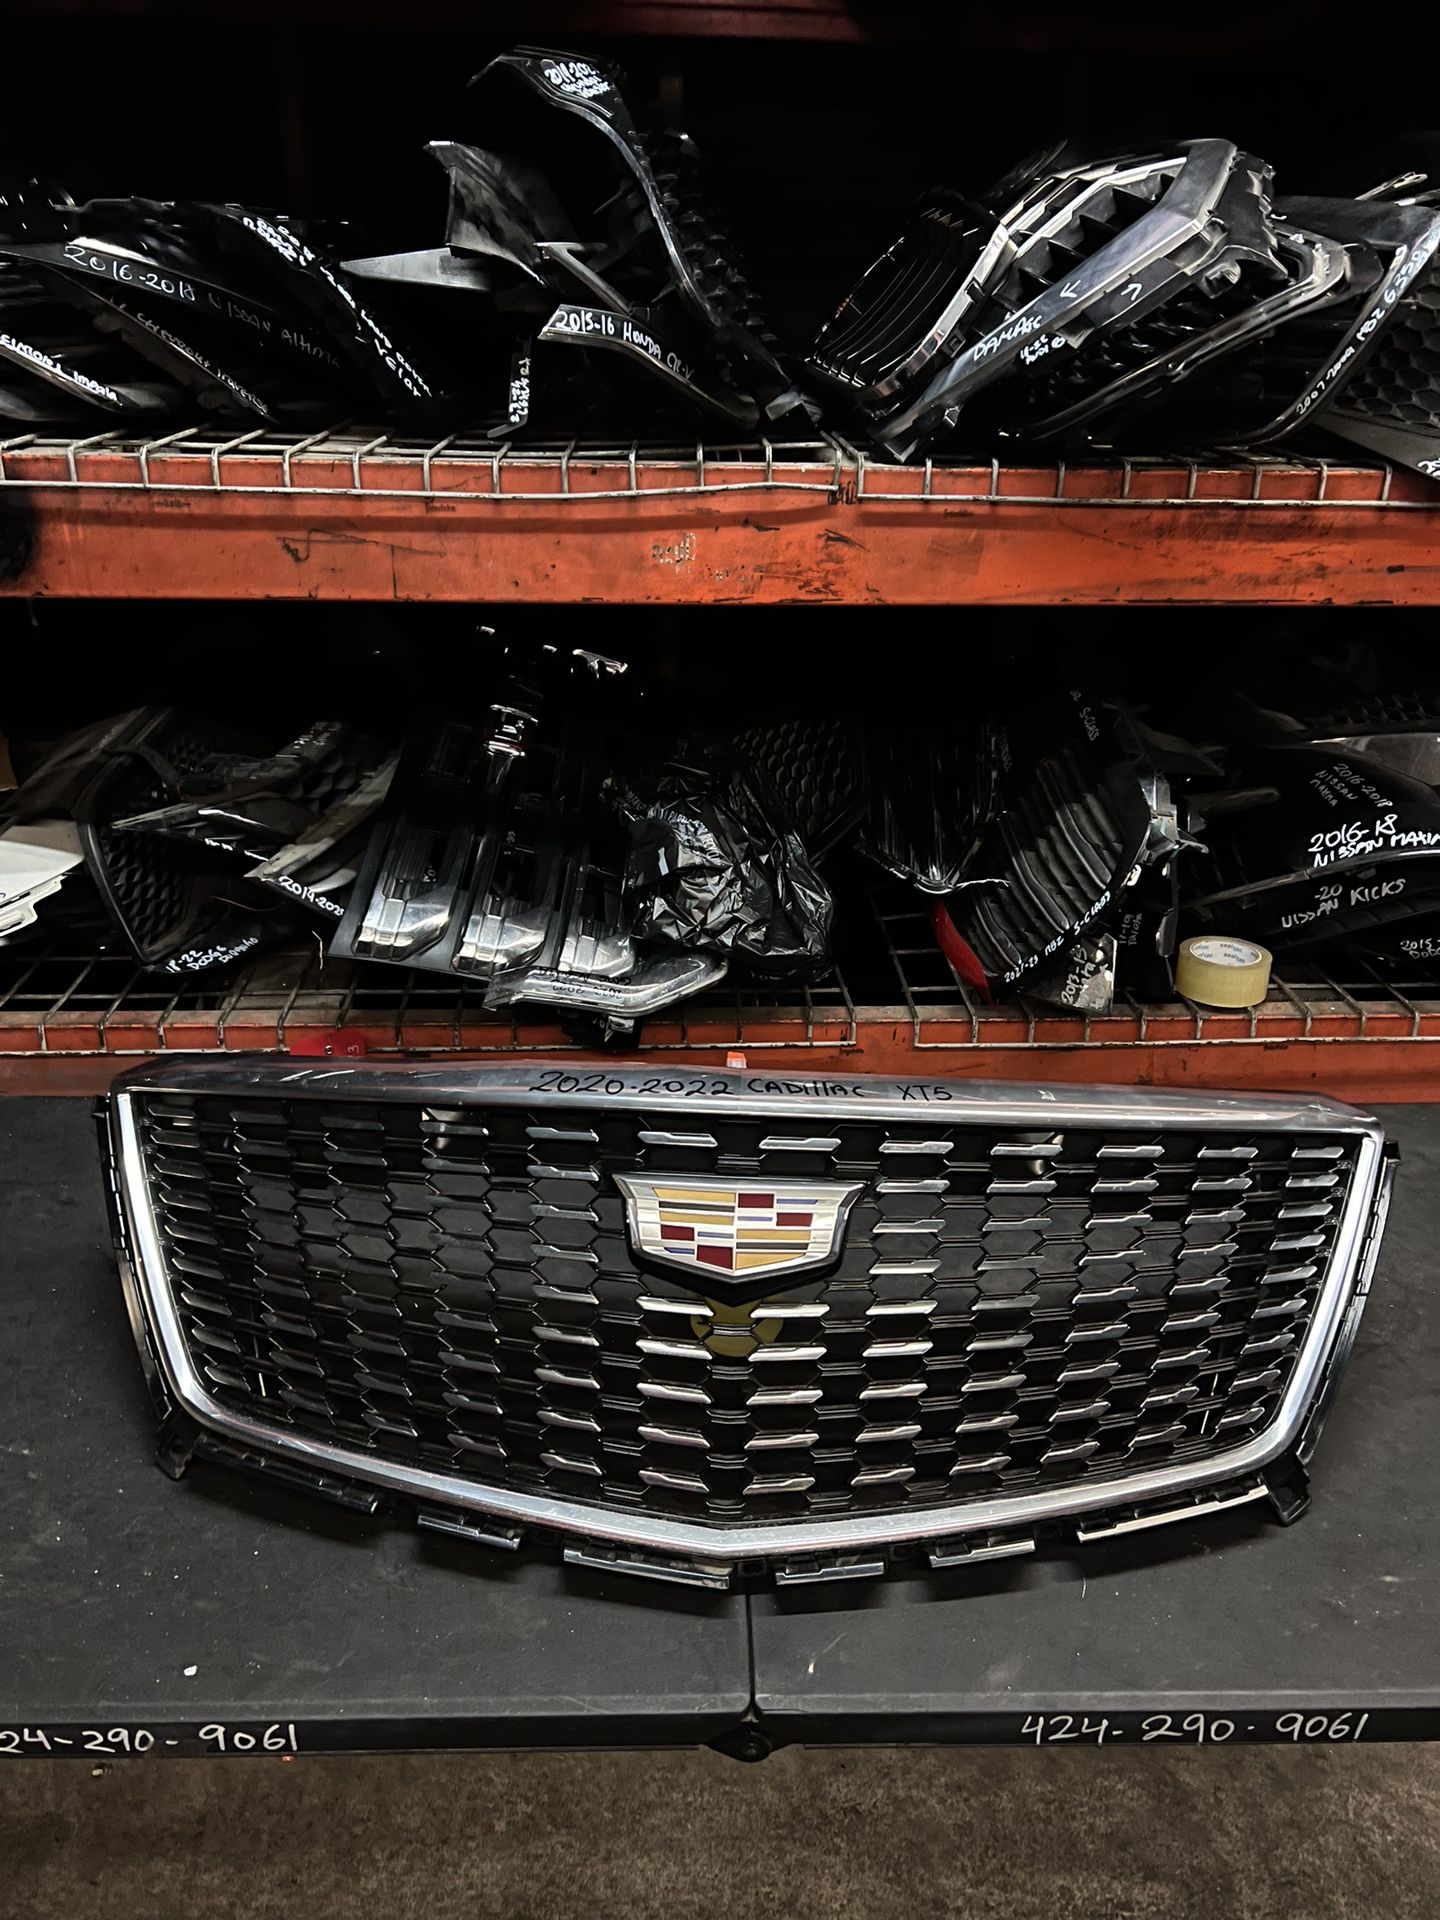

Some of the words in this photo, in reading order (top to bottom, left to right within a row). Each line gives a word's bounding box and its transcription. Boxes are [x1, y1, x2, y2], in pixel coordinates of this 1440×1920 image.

[555, 310, 616, 335] 2015-16
[622, 321, 662, 360] HONDA
[1313, 834, 1384, 867] NISSAN
[1349, 878, 1407, 908] KICKS
[529, 1071, 736, 1097] 2020-2022
[898, 1084, 953, 1103] XT5
